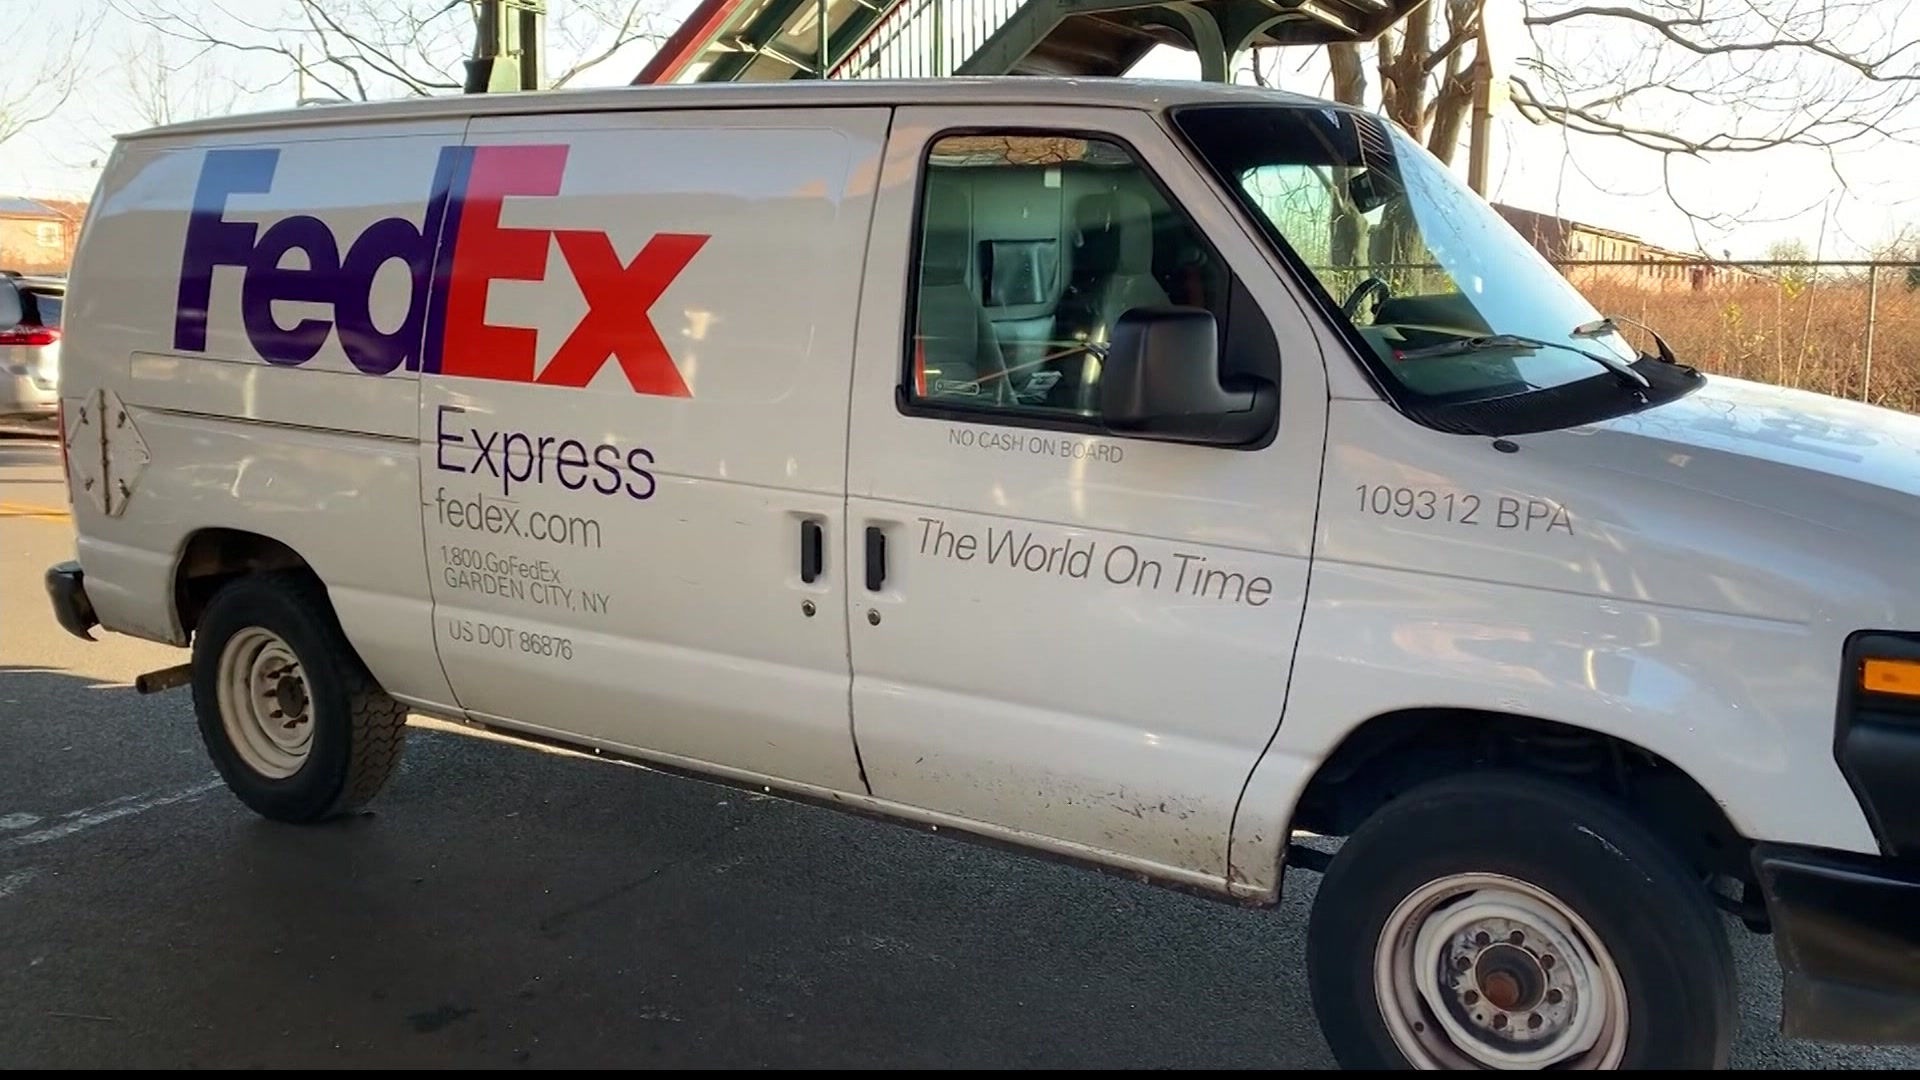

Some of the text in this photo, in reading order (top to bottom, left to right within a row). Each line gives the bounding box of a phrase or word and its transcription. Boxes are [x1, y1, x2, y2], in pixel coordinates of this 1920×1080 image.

[174, 144, 712, 398] FedEx
[437, 405, 656, 499] Express
[949, 428, 1124, 463] NO CASH ON BOARD
[435, 487, 601, 548] fedex.com
[1356, 484, 1574, 536] 109312 BPA
[441, 545, 562, 583] 1.800.GoFedEx
[917, 517, 1273, 606] The World On Time
[444, 567, 609, 614] GARDEN CITY, NY
[449, 621, 573, 660] US DOT 86876
